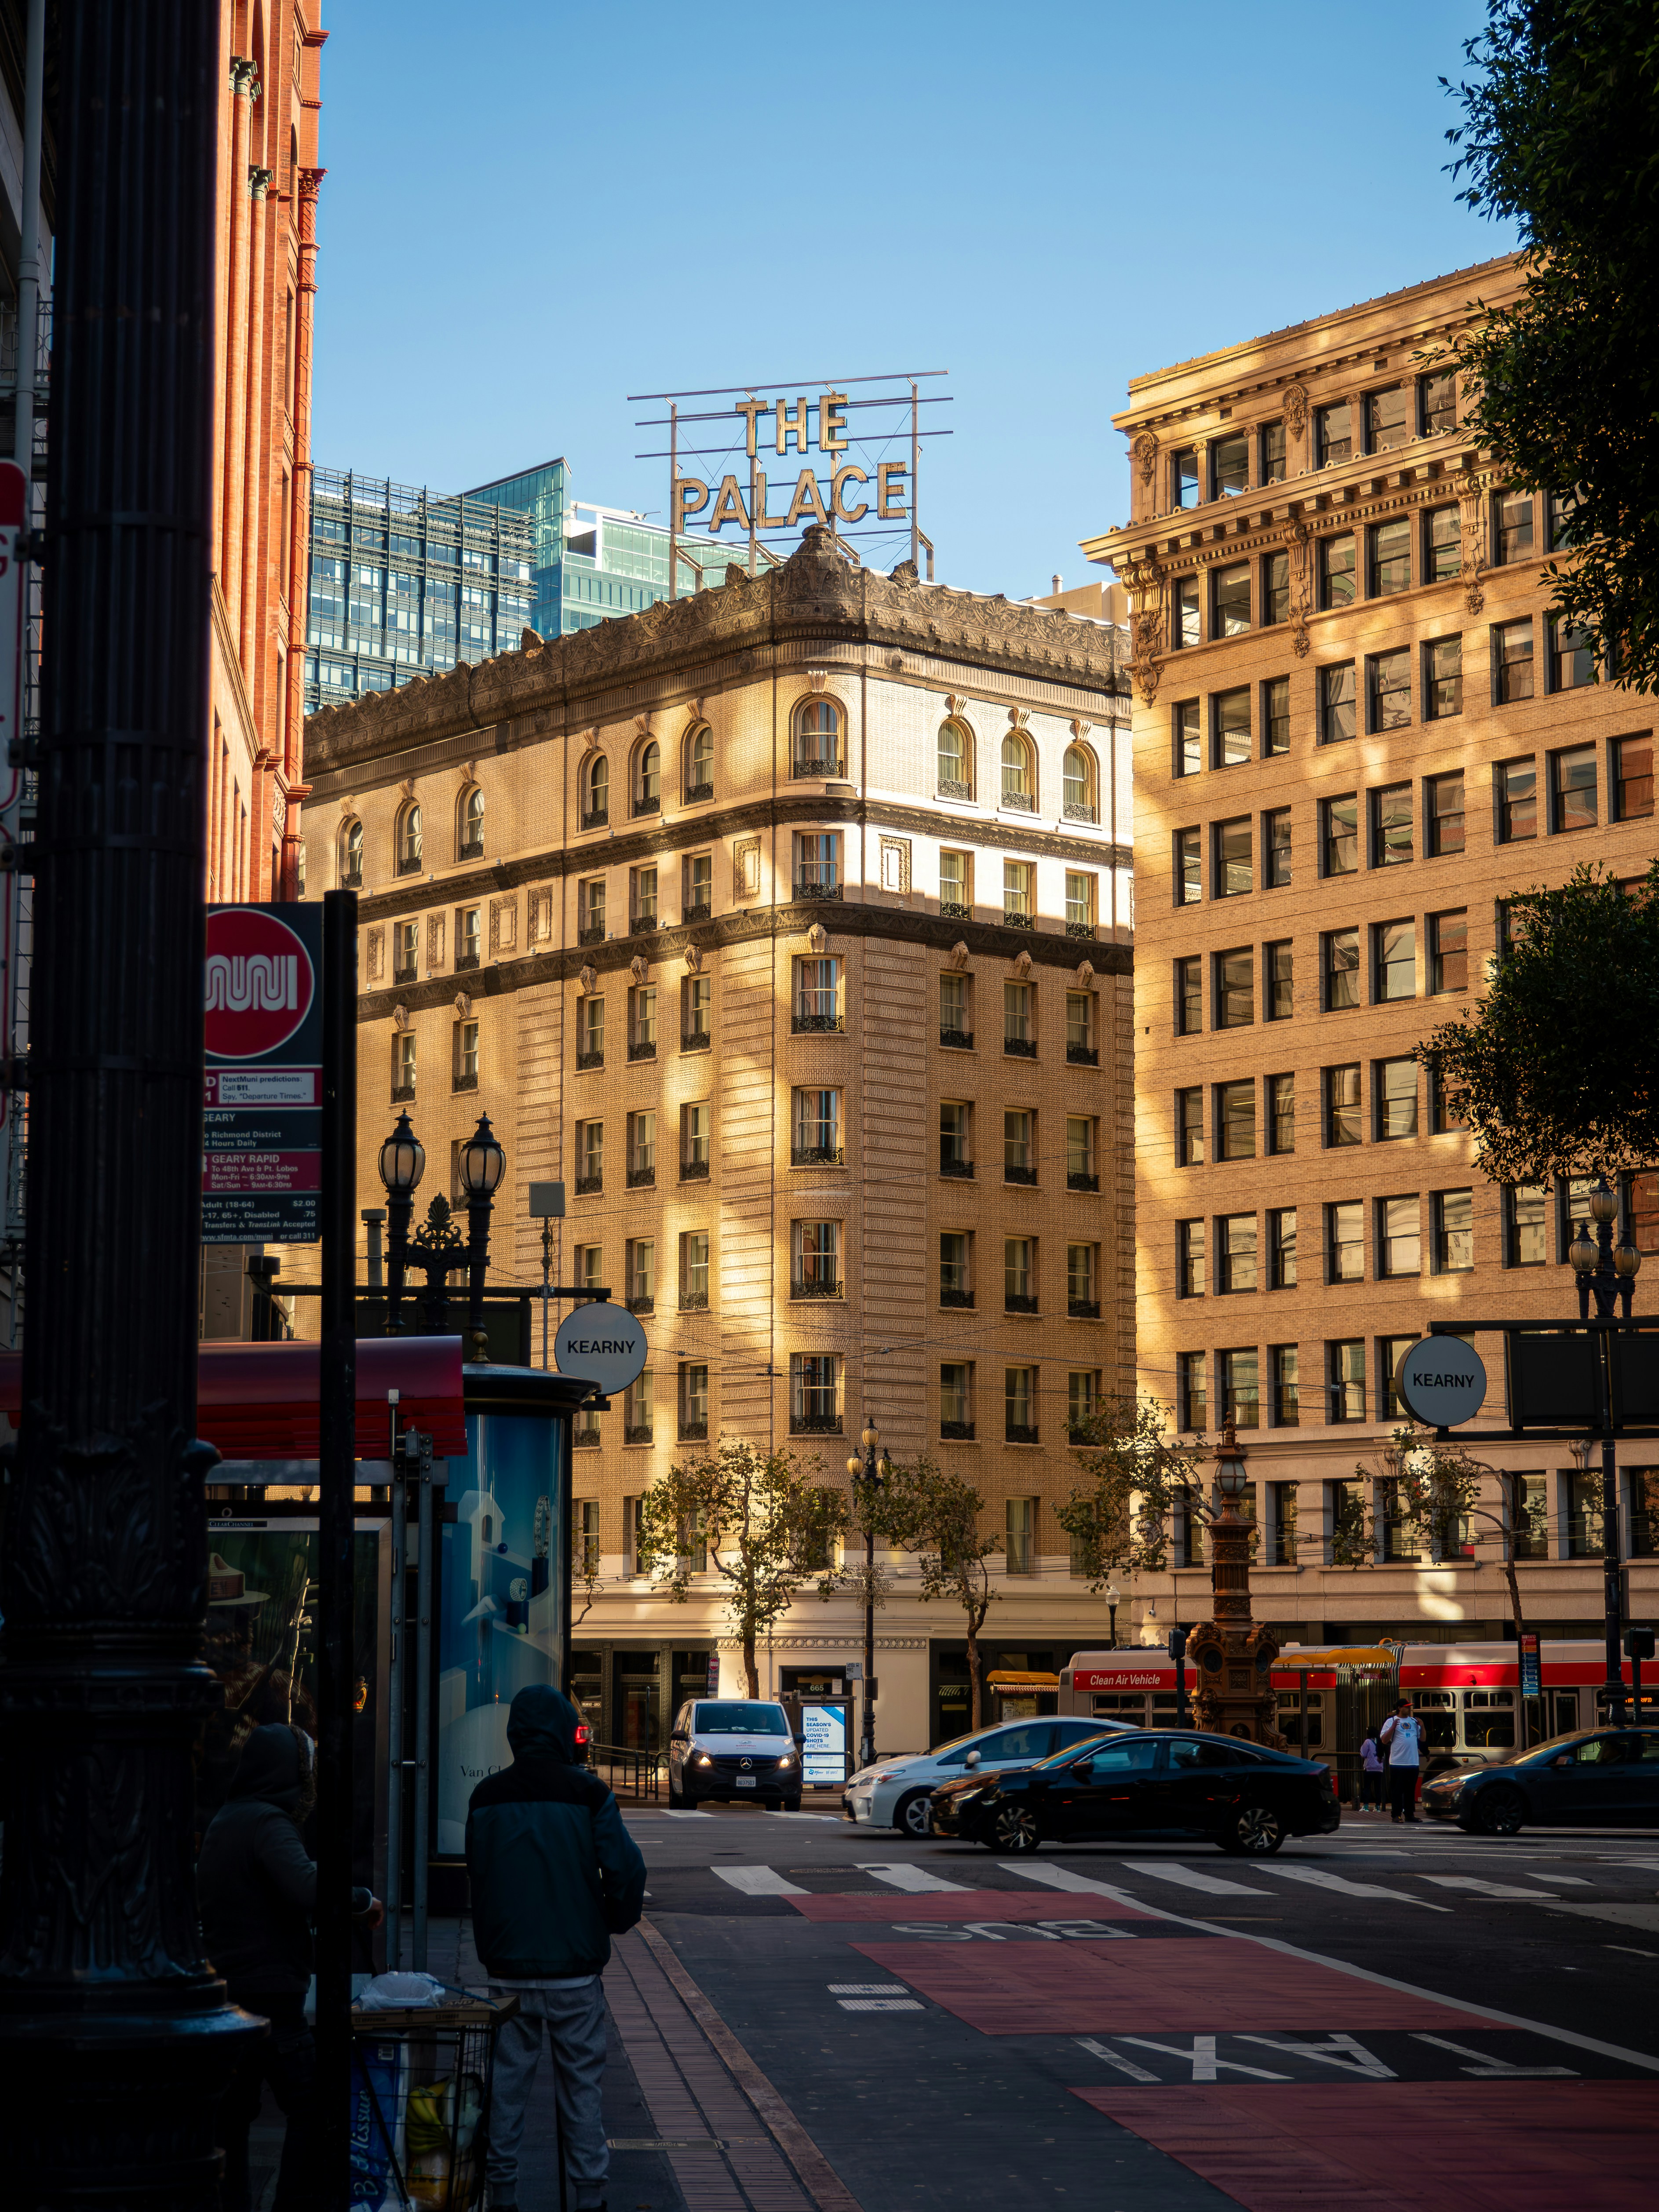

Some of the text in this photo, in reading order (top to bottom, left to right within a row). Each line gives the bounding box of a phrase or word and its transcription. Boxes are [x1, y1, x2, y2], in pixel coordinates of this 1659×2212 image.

[736, 394, 850, 458] THE
[675, 462, 907, 535] PALACE
[237, 1139, 257, 1148] Daily
[212, 1155, 246, 1164] GEARY
[249, 1154, 280, 1163] RAPID
[283, 1220, 316, 1228] Accepted
[568, 1340, 635, 1354] KEARNY
[1413, 1373, 1475, 1388] KEARNY
[1090, 1674, 1160, 1685] Clean Air Vehicle
[460, 1765, 484, 1777] Van
[891, 1919, 1138, 1941] BUS
[1071, 2033, 1582, 2081] TAXI
